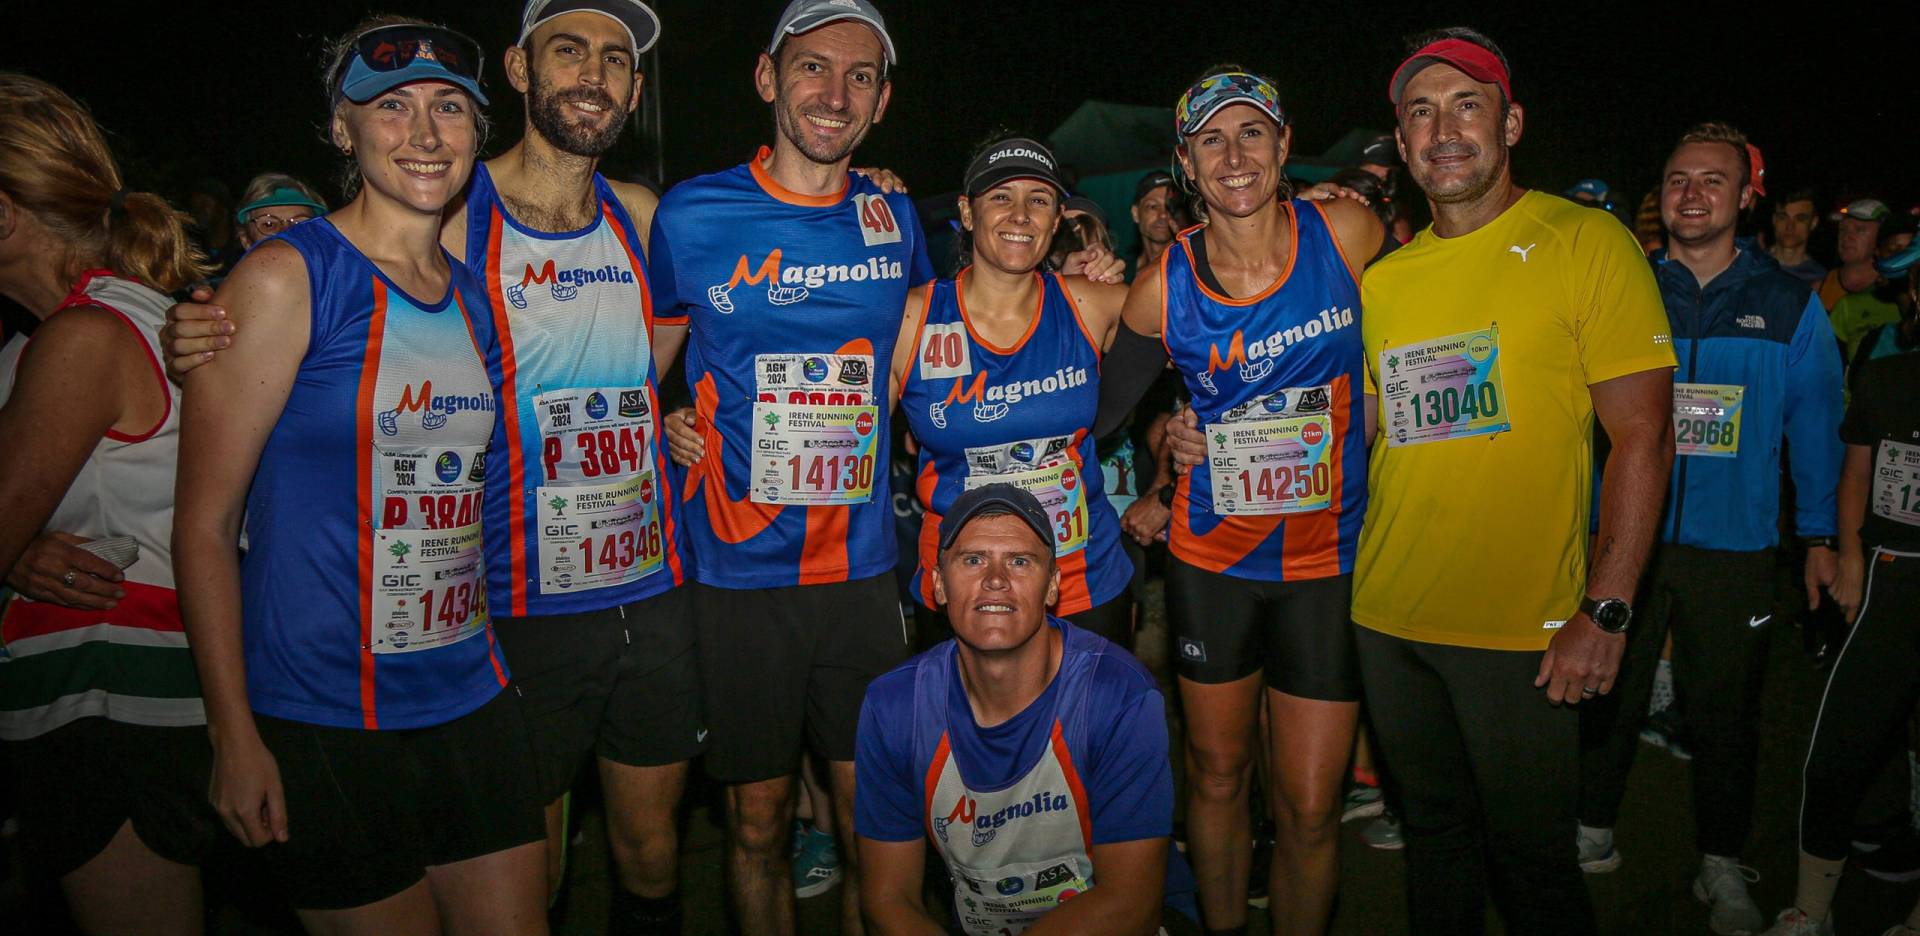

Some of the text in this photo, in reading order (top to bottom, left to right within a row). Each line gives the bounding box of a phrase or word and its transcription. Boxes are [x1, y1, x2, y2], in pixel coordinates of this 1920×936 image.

[988, 148, 1053, 171] SALOMON
[862, 198, 895, 233] 40
[522, 259, 633, 287] Magnolia
[728, 248, 903, 288] Magnolia
[1209, 305, 1354, 375] Magnolia
[923, 333, 964, 369] 40
[1404, 341, 1466, 359] IRENE RUNNING
[1405, 355, 1437, 367] FESTIVAL
[766, 363, 786, 373] AGN
[843, 362, 866, 375] ASA
[767, 373, 787, 384] 2024
[945, 370, 1087, 405] Magnolia
[1386, 380, 1408, 393] GIC
[621, 392, 645, 408] ASA
[1301, 391, 1324, 405] ASA
[1410, 381, 1498, 428] 13040
[549, 402, 570, 415] AGN
[551, 414, 571, 427] 2024
[788, 412, 854, 421] IRENE RUNNING
[788, 419, 826, 428] FESTIVAL
[856, 420, 872, 428] 21km
[1258, 425, 1299, 436] RUNNING
[1303, 430, 1322, 438] 21km
[1676, 418, 1735, 447] 2968
[758, 439, 788, 450] GIC
[1233, 436, 1269, 445] FESTIVAL
[544, 425, 645, 481] P 3841
[976, 455, 996, 463] AGN
[394, 459, 416, 472] AGN
[1213, 457, 1237, 467] GIC
[788, 455, 873, 491] 14130
[1880, 467, 1904, 478] GIC
[395, 473, 416, 486] 2024
[1021, 473, 1059, 487] RUNNING
[1238, 462, 1329, 502] 14250
[576, 484, 639, 502] IRENE RUNNING
[576, 500, 616, 510] FESTIVAL
[383, 497, 408, 530] P
[545, 525, 579, 536] GIC
[421, 535, 449, 548] IRENE
[579, 520, 660, 573] 14346
[420, 546, 460, 557] FESTIVAL
[382, 574, 420, 587] GIC
[948, 792, 1069, 829] Magnolia
[1040, 865, 1069, 884] ASA
[1009, 895, 1053, 908] RUNNING
